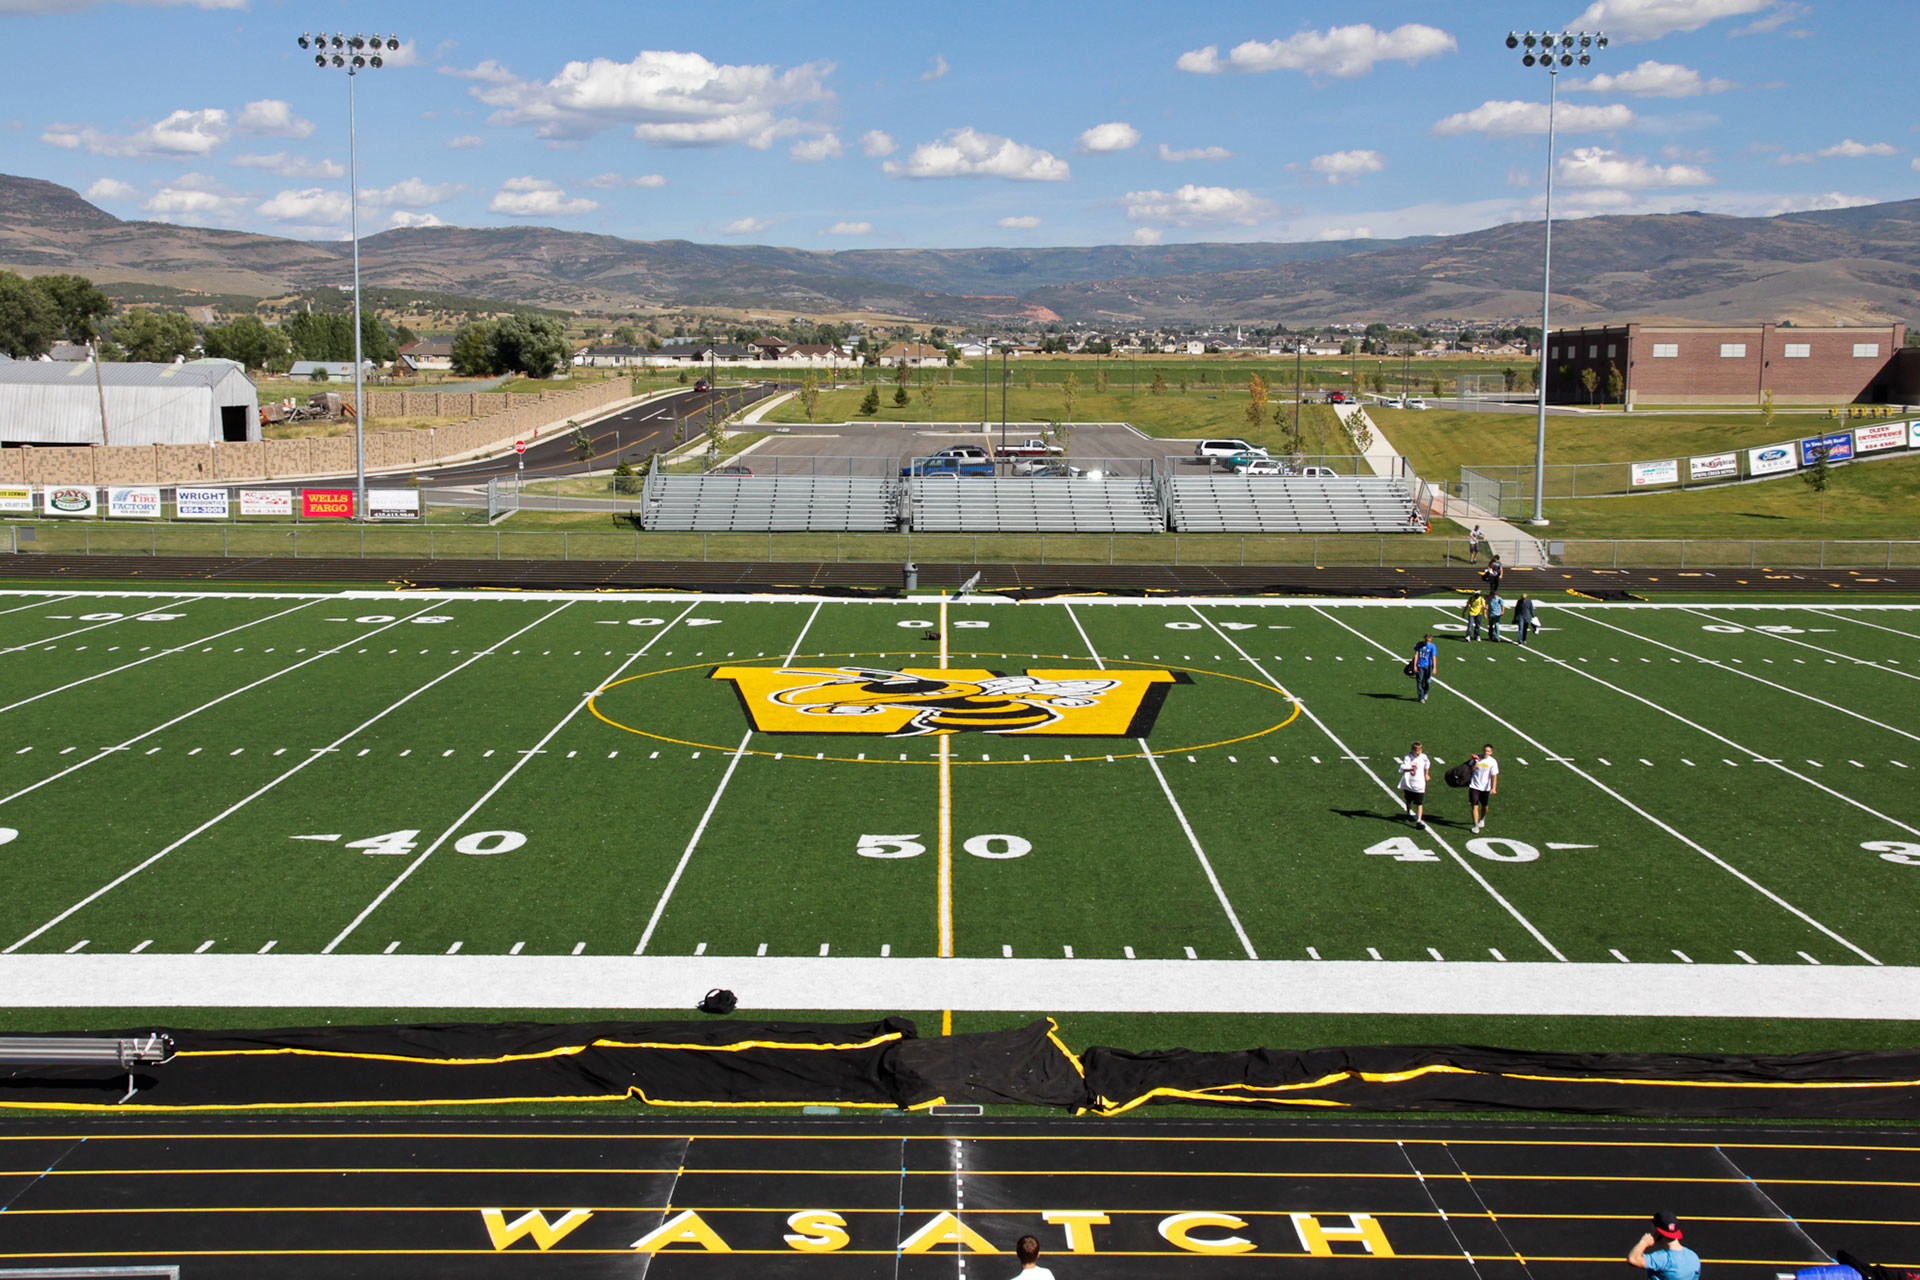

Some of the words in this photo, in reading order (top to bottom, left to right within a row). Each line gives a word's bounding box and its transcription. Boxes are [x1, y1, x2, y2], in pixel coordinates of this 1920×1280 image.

[1761, 450, 1785, 460] Ford
[1756, 460, 1791, 470] LABRUM
[131, 494, 157, 503] TIRE
[179, 492, 226, 500] WRIGHT
[308, 494, 348, 502] WELLS
[310, 504, 348, 512] FARGO
[345, 829, 528, 855] 40
[856, 834, 1033, 859] 50
[1363, 836, 1541, 863] 40
[480, 1208, 1396, 1257] WASATCH
